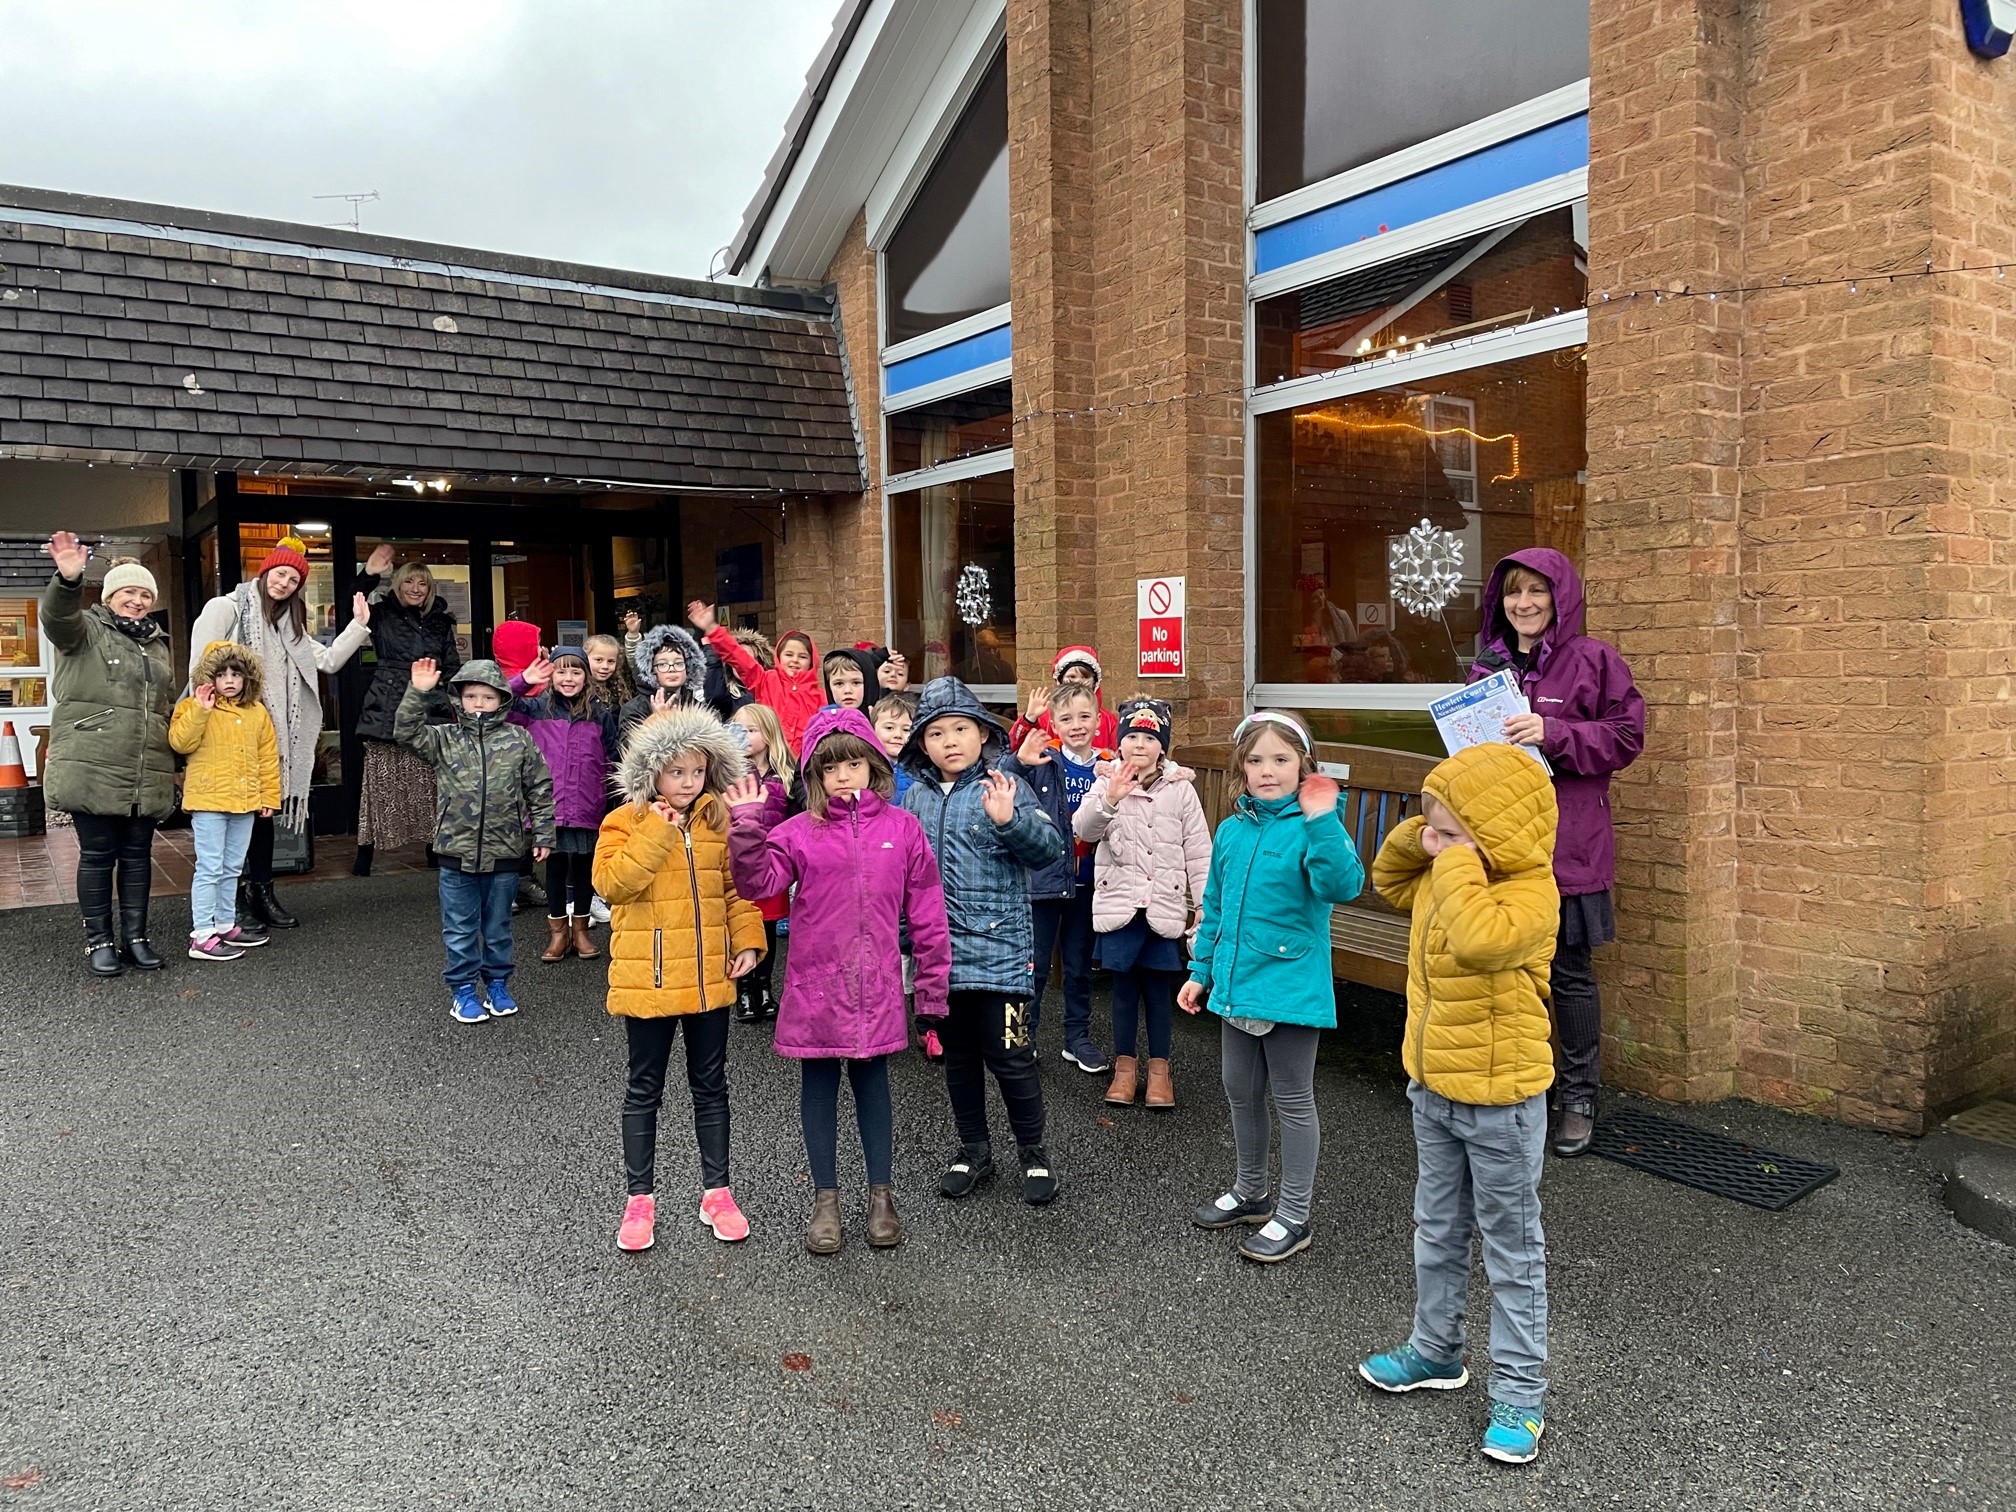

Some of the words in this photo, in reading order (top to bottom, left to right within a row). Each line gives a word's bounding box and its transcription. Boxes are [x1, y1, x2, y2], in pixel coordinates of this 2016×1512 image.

[1152, 626, 1168, 641] No
[1141, 647, 1180, 666] parking
[1434, 694, 1462, 712] Hewlett
[1463, 685, 1486, 700] Court
[1437, 702, 1466, 717] Newsletter
